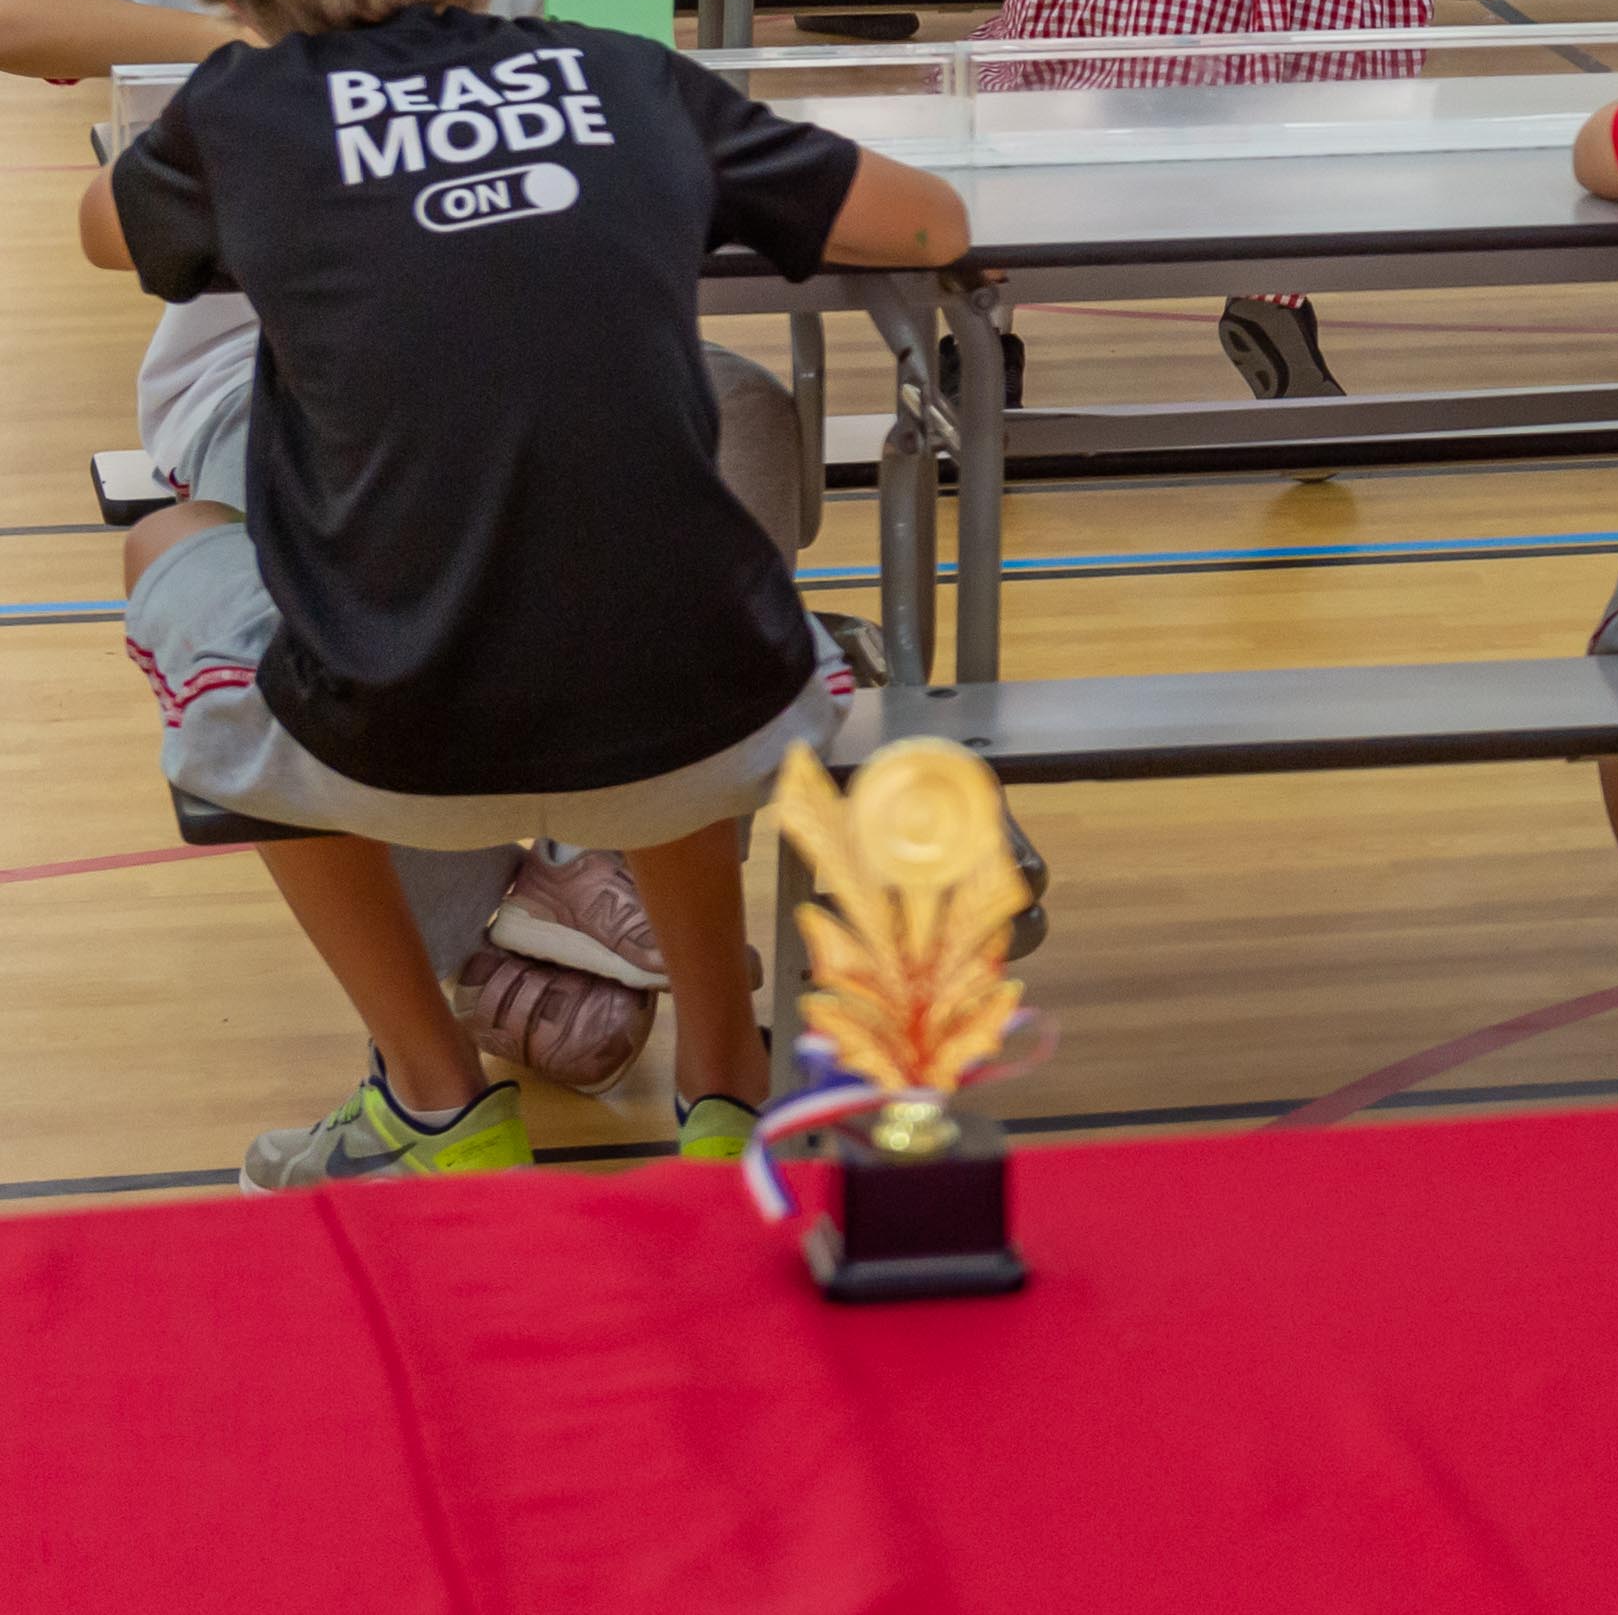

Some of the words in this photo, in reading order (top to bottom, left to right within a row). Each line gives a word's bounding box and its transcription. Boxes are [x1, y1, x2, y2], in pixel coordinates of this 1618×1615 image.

[327, 48, 588, 124] BEAST
[336, 95, 615, 185] MODE
[441, 180, 511, 219] ON
